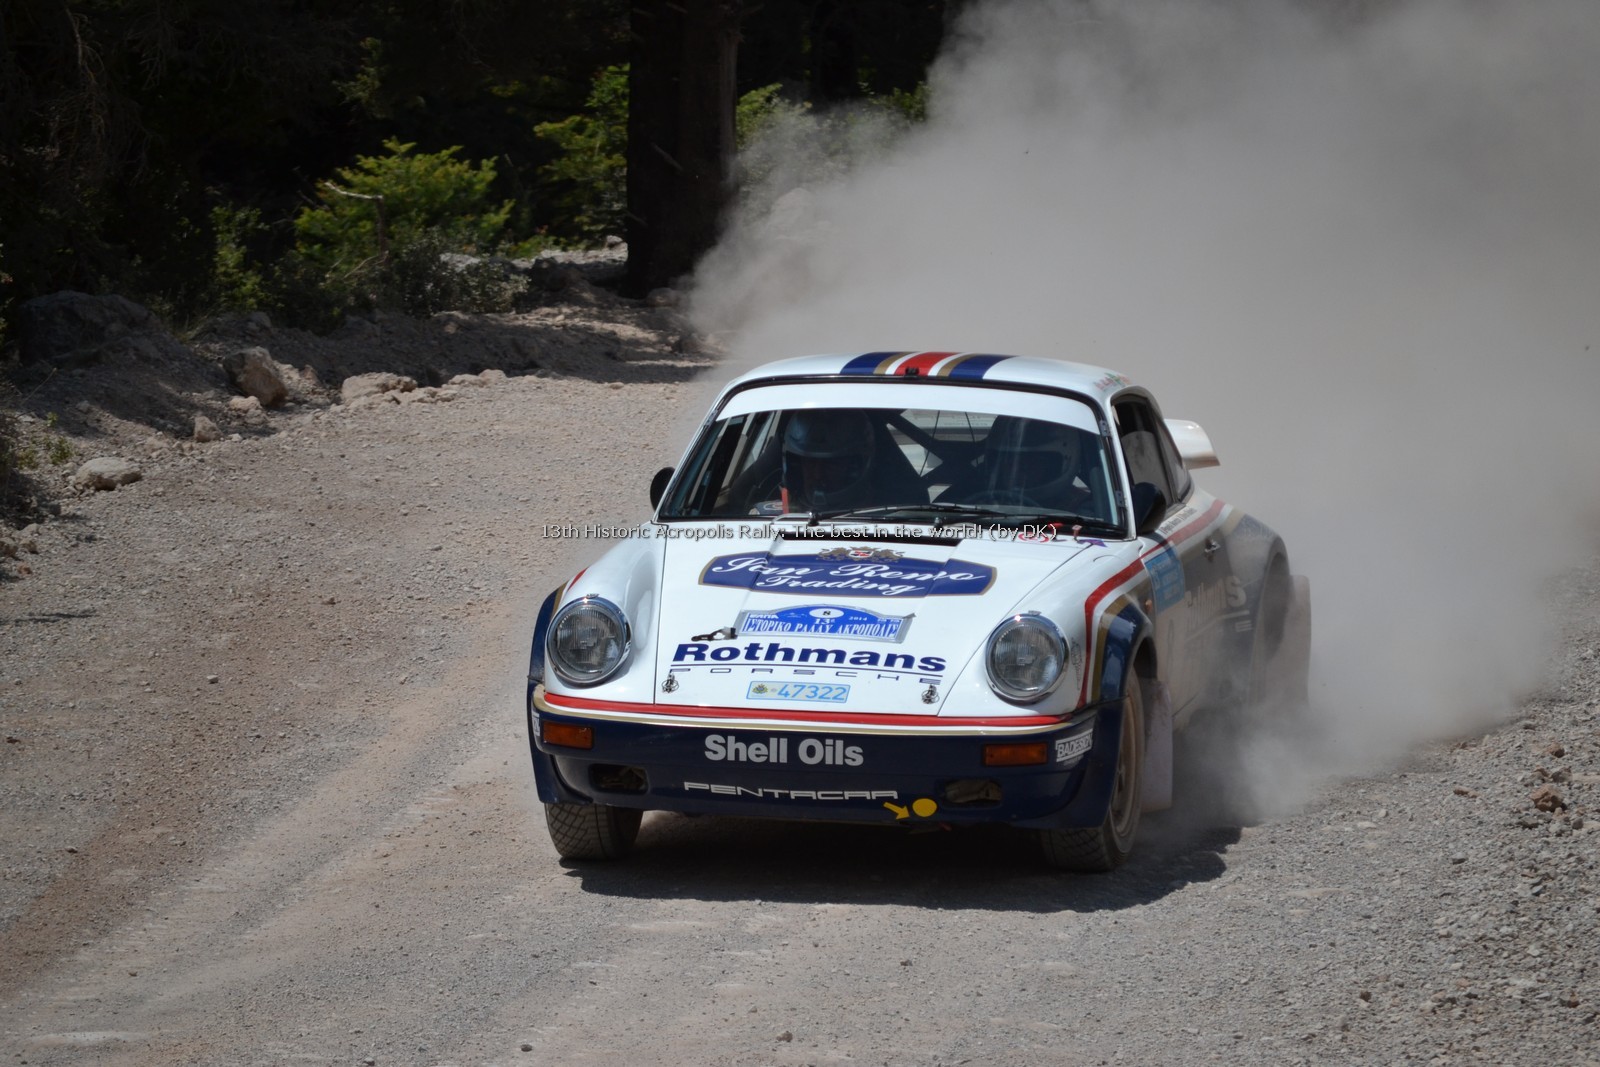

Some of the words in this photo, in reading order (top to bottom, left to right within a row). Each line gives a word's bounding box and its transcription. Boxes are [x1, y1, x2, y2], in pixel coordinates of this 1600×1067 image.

[829, 563, 986, 581] Remo
[756, 575, 925, 596] Trading
[672, 642, 947, 672] Rothmans
[669, 667, 942, 685] PORSCHE
[777, 684, 848, 701] 47322
[704, 734, 788, 763] Shell
[798, 738, 864, 767] Oils
[684, 781, 899, 800] PENTACAR
